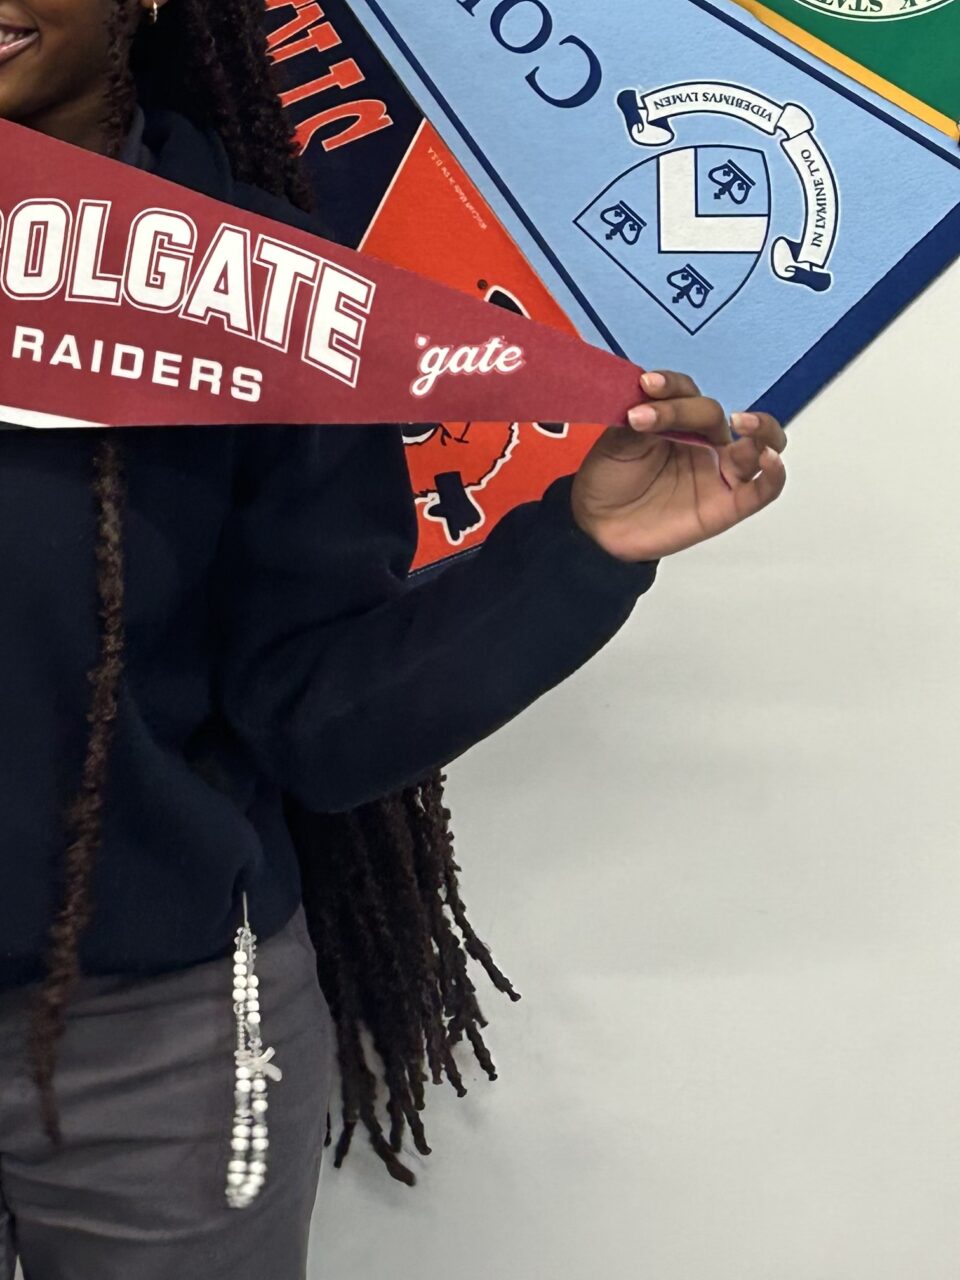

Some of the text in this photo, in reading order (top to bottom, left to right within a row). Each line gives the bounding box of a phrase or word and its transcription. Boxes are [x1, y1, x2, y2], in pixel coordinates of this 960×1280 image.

[653, 92, 699, 110] LVMEN
[801, 149, 828, 248] IN LVMINE TVO
[12, 325, 263, 404] RAIDERS
